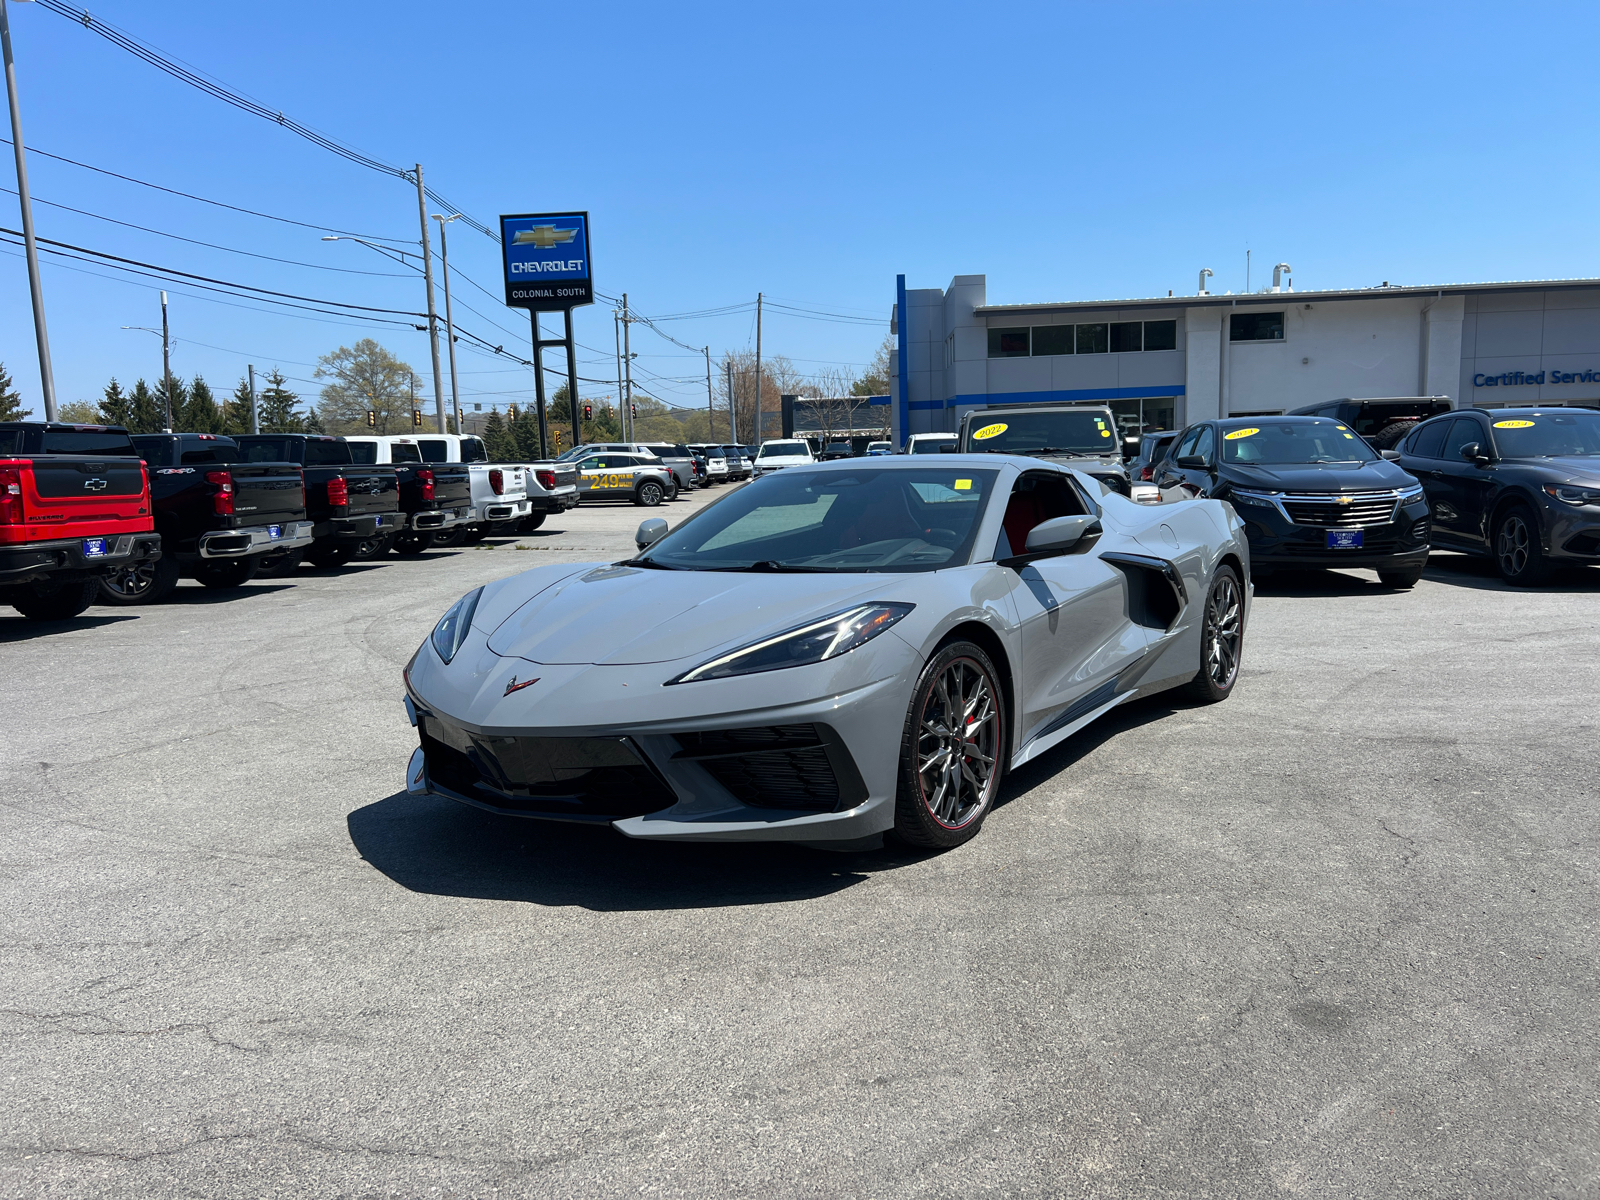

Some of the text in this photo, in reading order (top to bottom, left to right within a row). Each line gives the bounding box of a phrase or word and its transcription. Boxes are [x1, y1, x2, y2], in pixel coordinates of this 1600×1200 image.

[511, 260, 583, 273] CHEVROLET
[513, 288, 585, 298] COLONIAL SOUTH
[1474, 371, 1545, 387] Certified
[979, 424, 1002, 438] 2022
